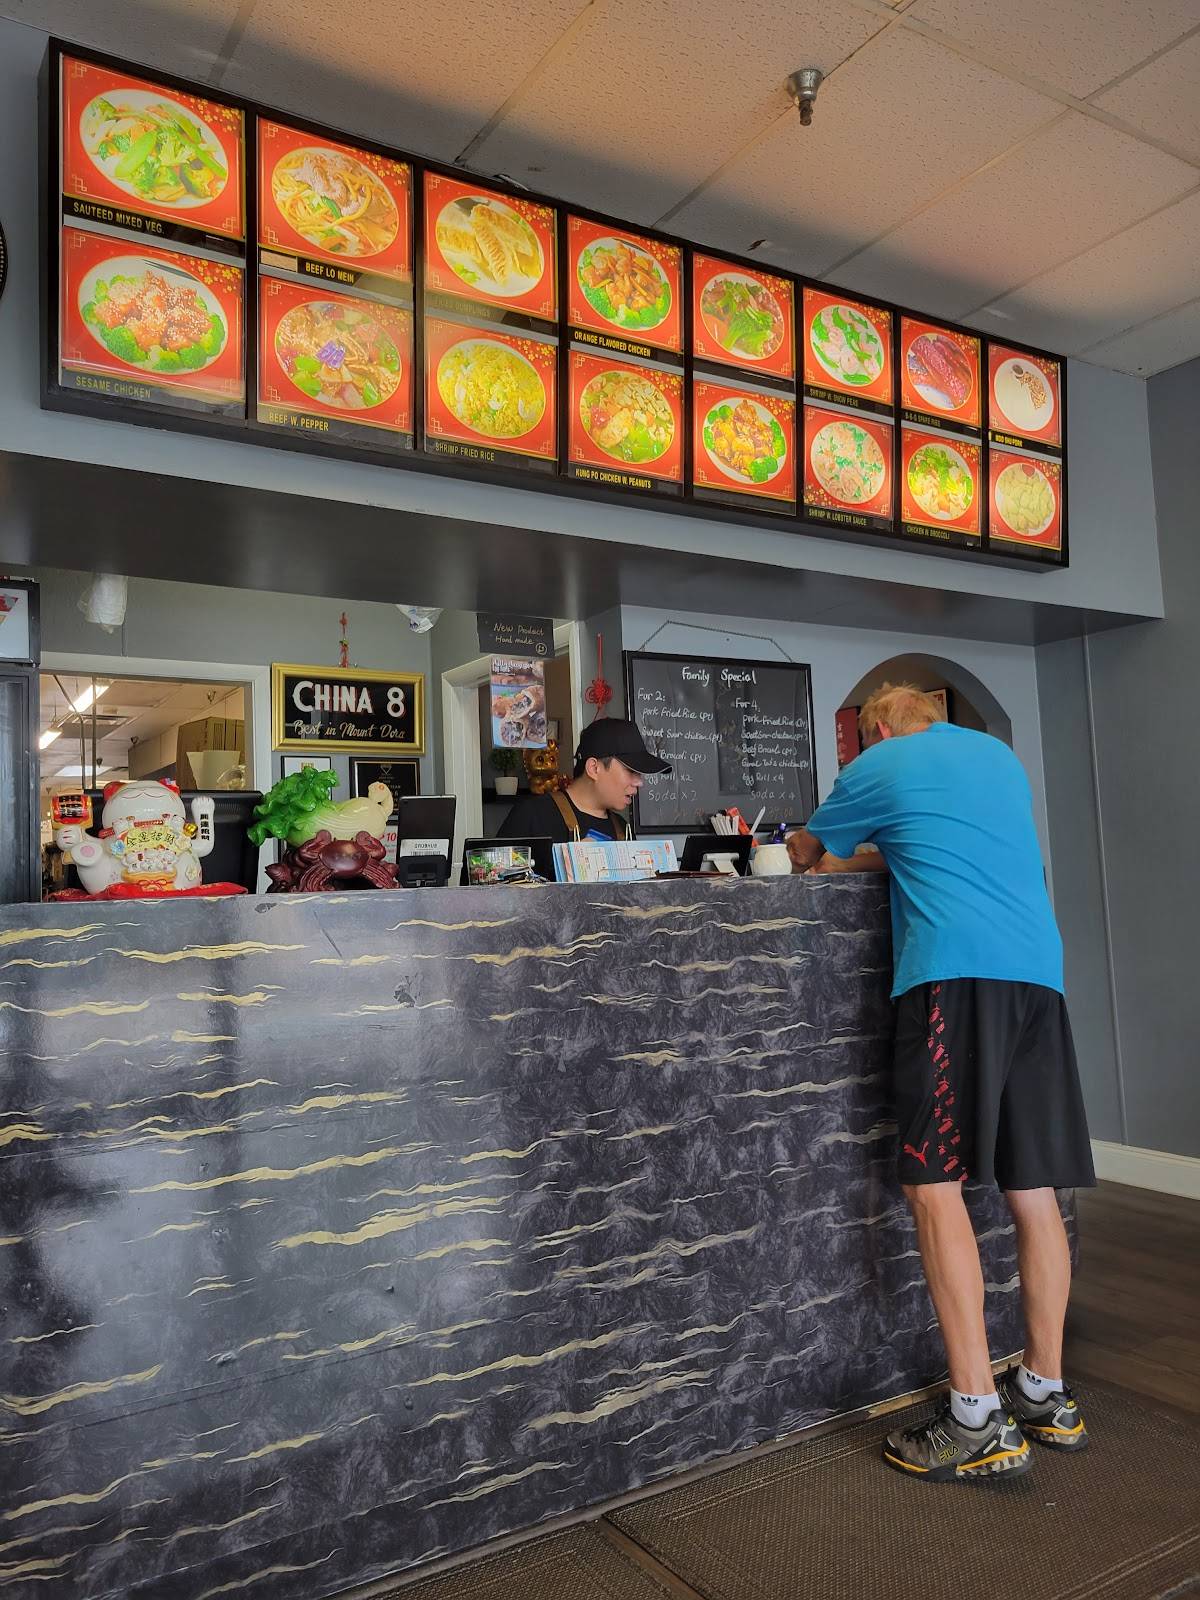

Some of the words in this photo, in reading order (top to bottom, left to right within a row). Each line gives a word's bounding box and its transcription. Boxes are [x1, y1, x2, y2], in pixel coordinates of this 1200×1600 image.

[74, 202, 114, 220] SAUTEED
[116, 212, 143, 228] MIXED
[145, 221, 164, 234] VEG.
[306, 262, 323, 276] BEEF
[326, 266, 336, 278] LO
[338, 270, 354, 283] MEIN
[574, 331, 598, 344] ORANGE
[599, 337, 626, 352] FLAVORED
[628, 344, 651, 357] CHICKEN
[76, 376, 110, 391] SESAME
[114, 384, 150, 398] CHICKEN
[269, 412, 287, 424] BEEF
[301, 418, 329, 431] PEPPER
[435, 442, 458, 455] SHRIMP
[460, 447, 478, 458] FRIED
[481, 450, 494, 461] RICE
[576, 468, 590, 479] KUNG
[591, 470, 598, 479] PO
[600, 472, 621, 483] CHICKEN
[629, 477, 651, 489] PEANUTS
[809, 508, 825, 517] SHRIMP
[832, 513, 852, 523] LOBSTER
[853, 516, 867, 526] SAUCE
[494, 623, 513, 632] New
[515, 636, 535, 644] made
[682, 667, 710, 687] Family
[721, 668, 756, 687] Special
[292, 680, 373, 713] CHINA
[387, 686, 405, 718] 8
[638, 688, 653, 701] For
[656, 691, 665, 701] 2:
[736, 698, 750, 708] For
[643, 706, 659, 719] pork
[293, 720, 322, 736] Best
[325, 722, 336, 736] in
[340, 722, 376, 737] Mount
[380, 724, 405, 739] Dora
[642, 727, 664, 737] Sweet
[667, 729, 682, 738] Sour
[648, 790, 676, 801] Soda
[938, 1445, 959, 1464] FILA
